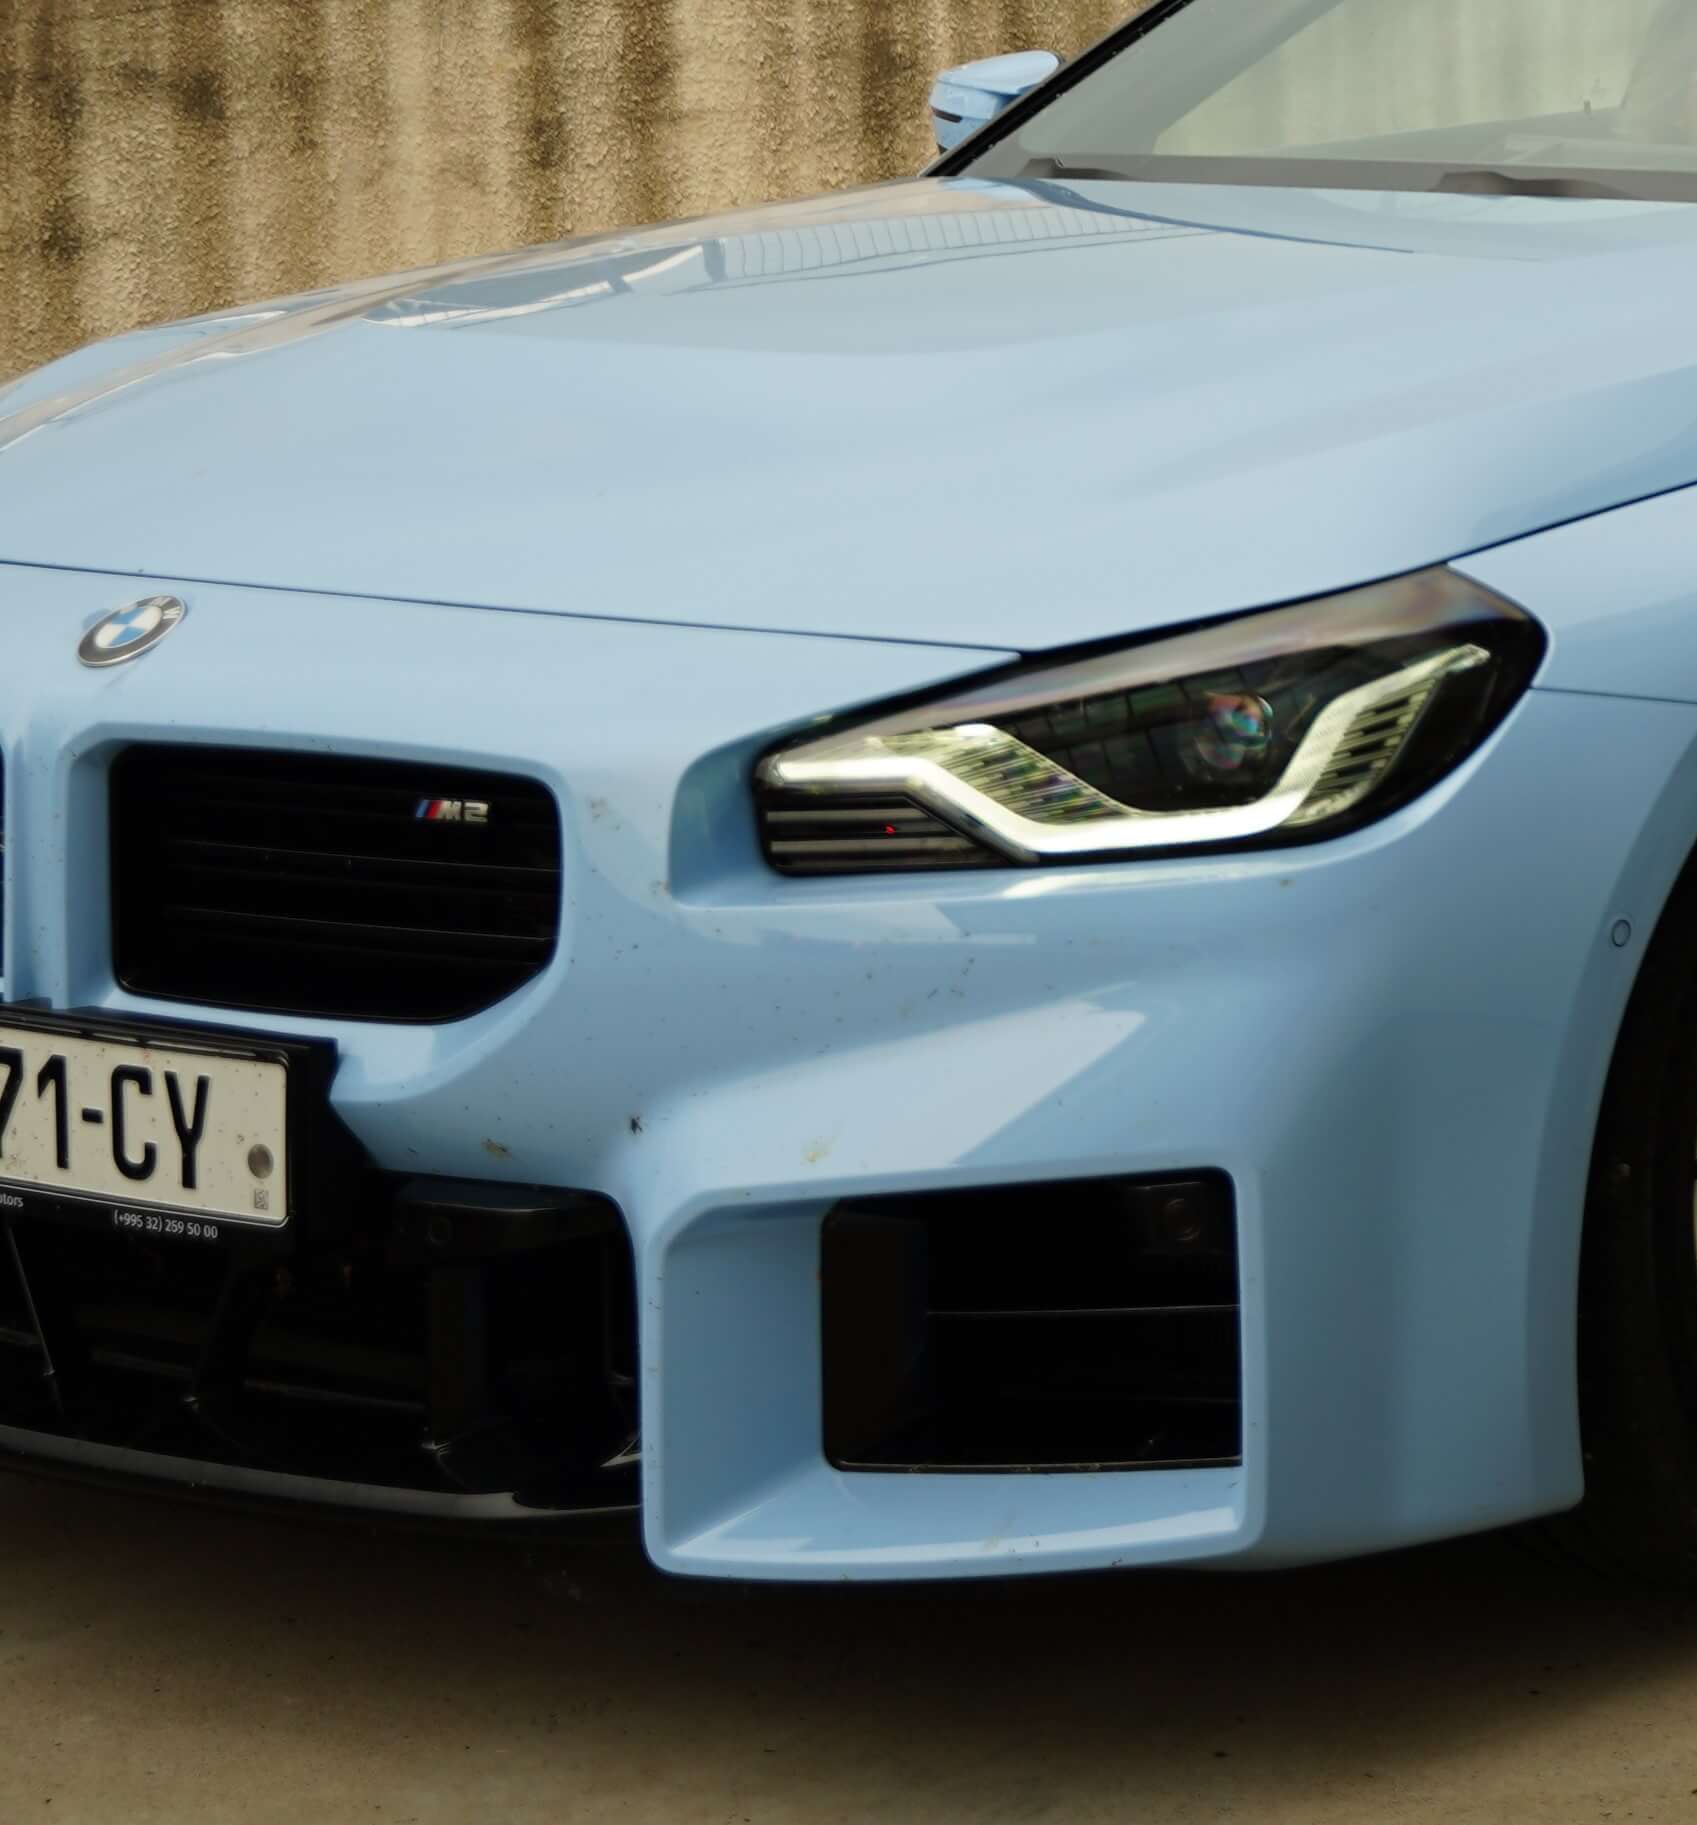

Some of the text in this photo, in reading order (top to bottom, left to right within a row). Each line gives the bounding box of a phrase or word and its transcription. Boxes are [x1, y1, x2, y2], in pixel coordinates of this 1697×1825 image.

[436, 799, 489, 823] M2
[146, 1215, 163, 1233] 32)
[187, 1222, 201, 1236] 50
[203, 1225, 218, 1239] 00
